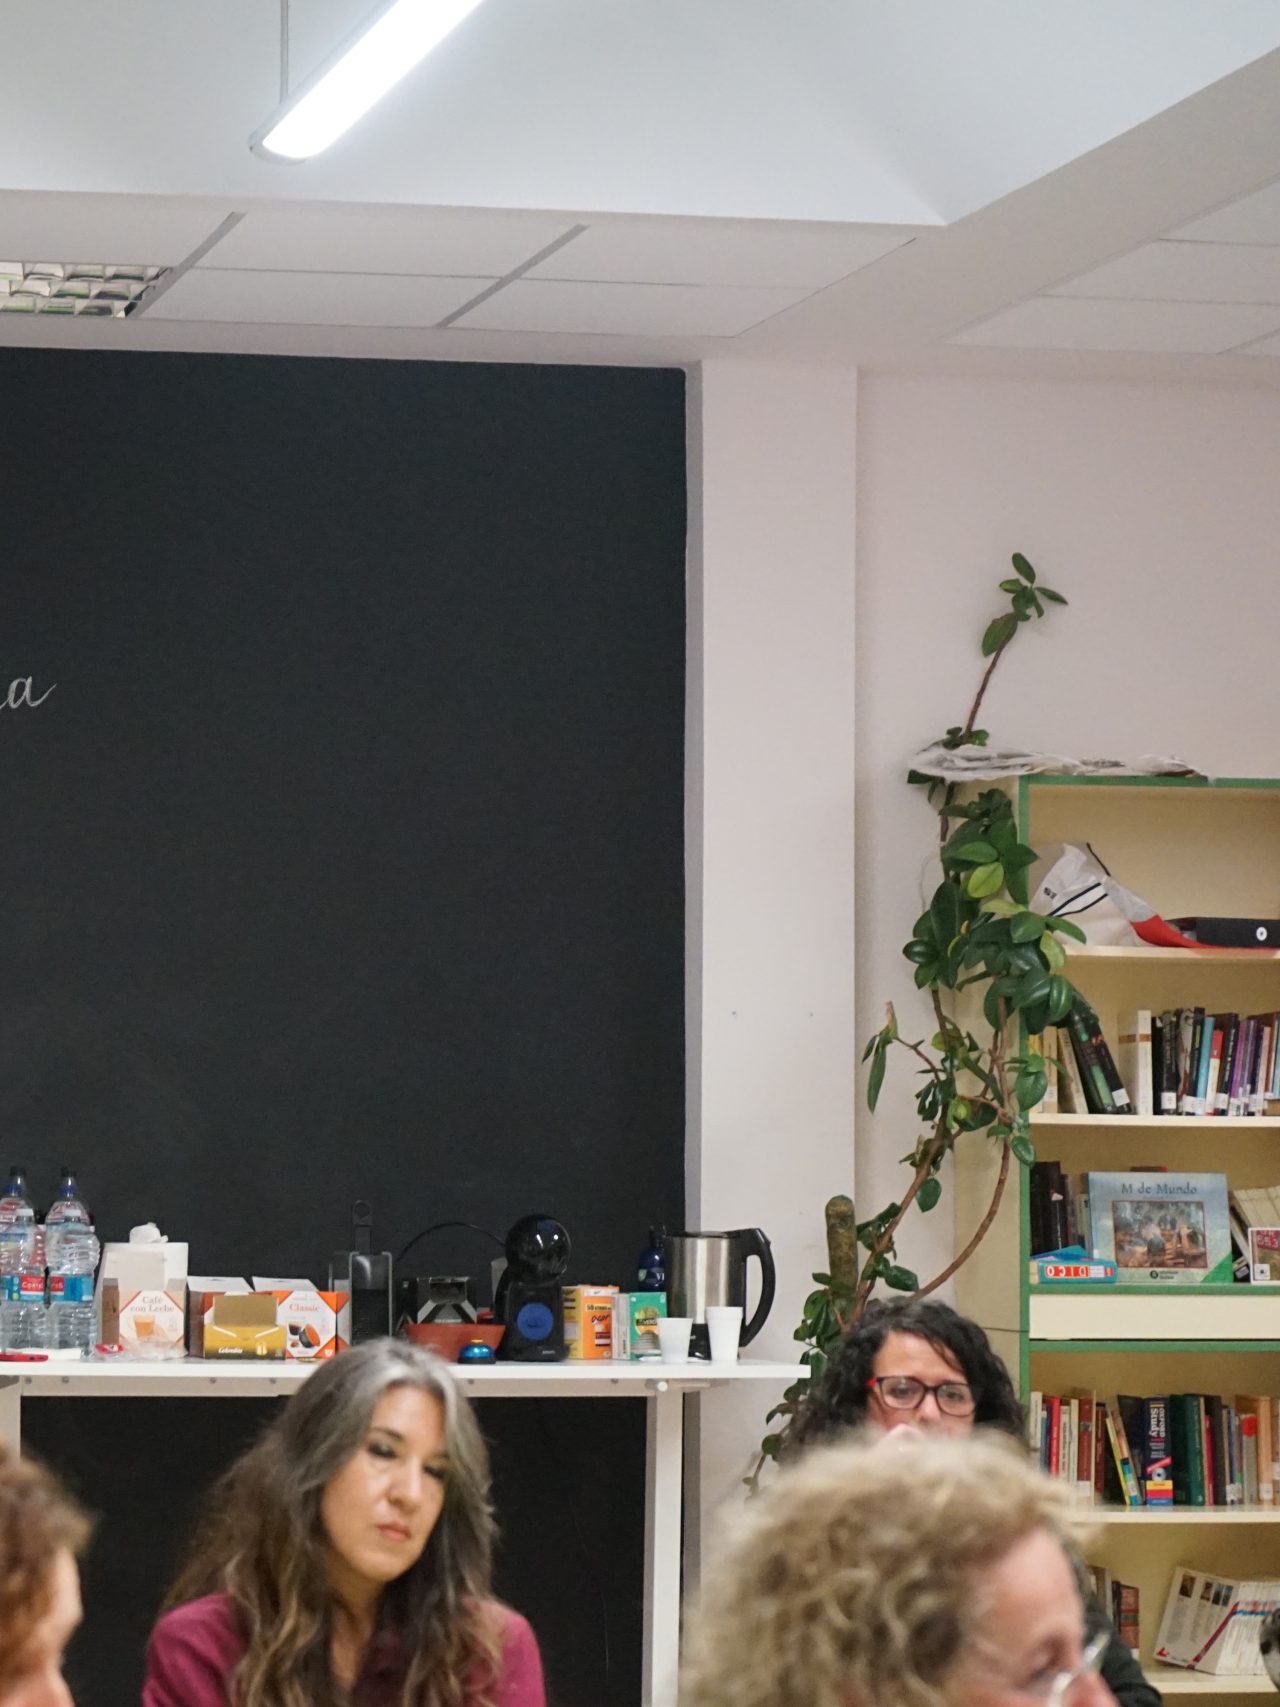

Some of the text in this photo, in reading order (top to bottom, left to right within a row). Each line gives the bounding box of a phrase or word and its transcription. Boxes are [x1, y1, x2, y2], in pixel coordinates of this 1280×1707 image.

[1121, 1181, 1198, 1194] M de Mundo
[149, 1304, 175, 1312] Leche
[289, 1303, 320, 1312] Classic
[1149, 1408, 1159, 1437] Study
